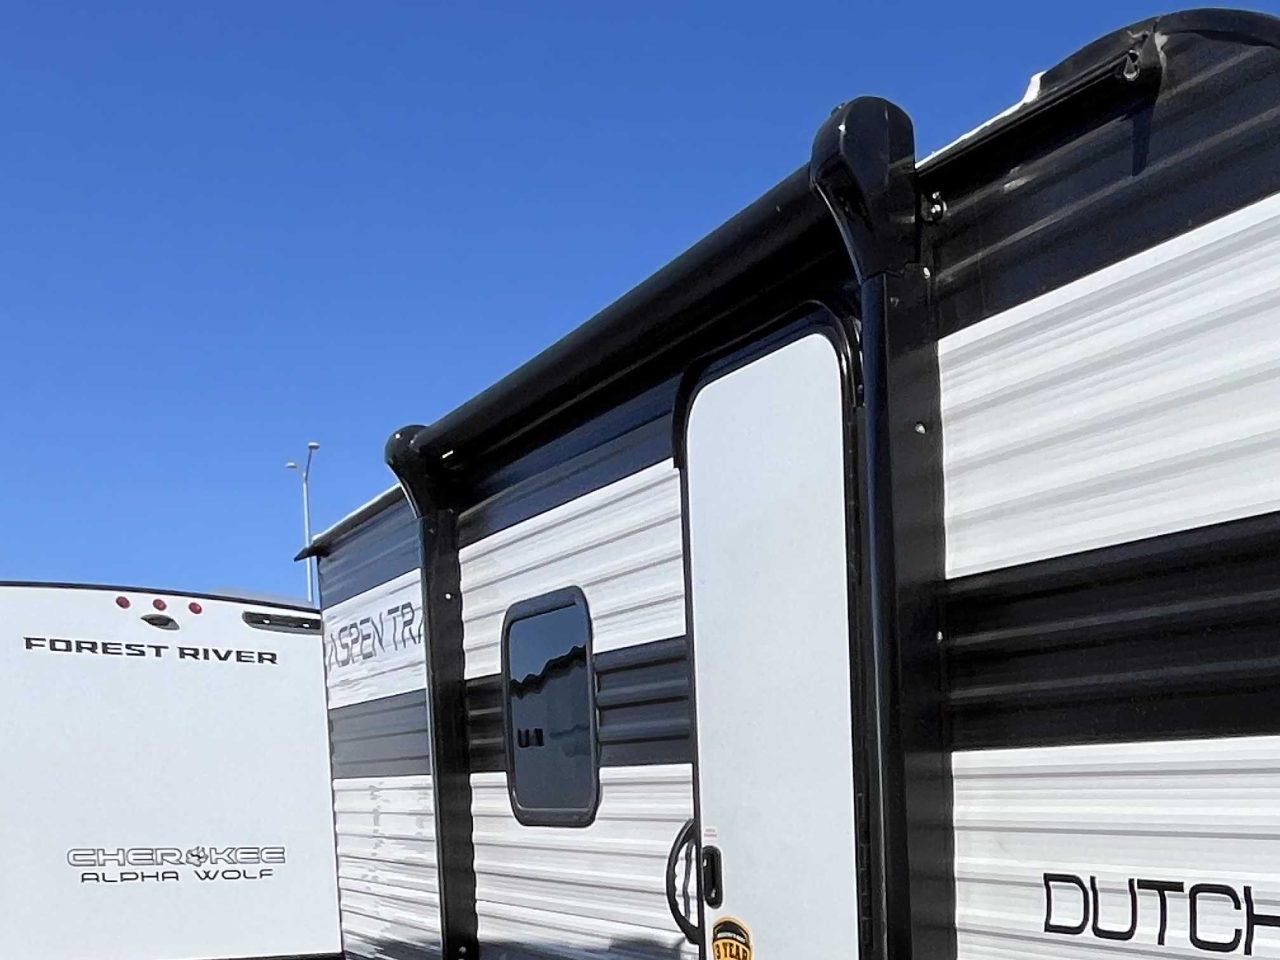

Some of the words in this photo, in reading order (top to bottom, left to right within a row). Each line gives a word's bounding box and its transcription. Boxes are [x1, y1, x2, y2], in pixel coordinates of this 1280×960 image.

[23, 636, 169, 658] FOREST
[178, 646, 279, 665] RIVER
[327, 612, 386, 672] ASPEN
[80, 870, 180, 883] ALPHA
[194, 868, 274, 881] WOLF
